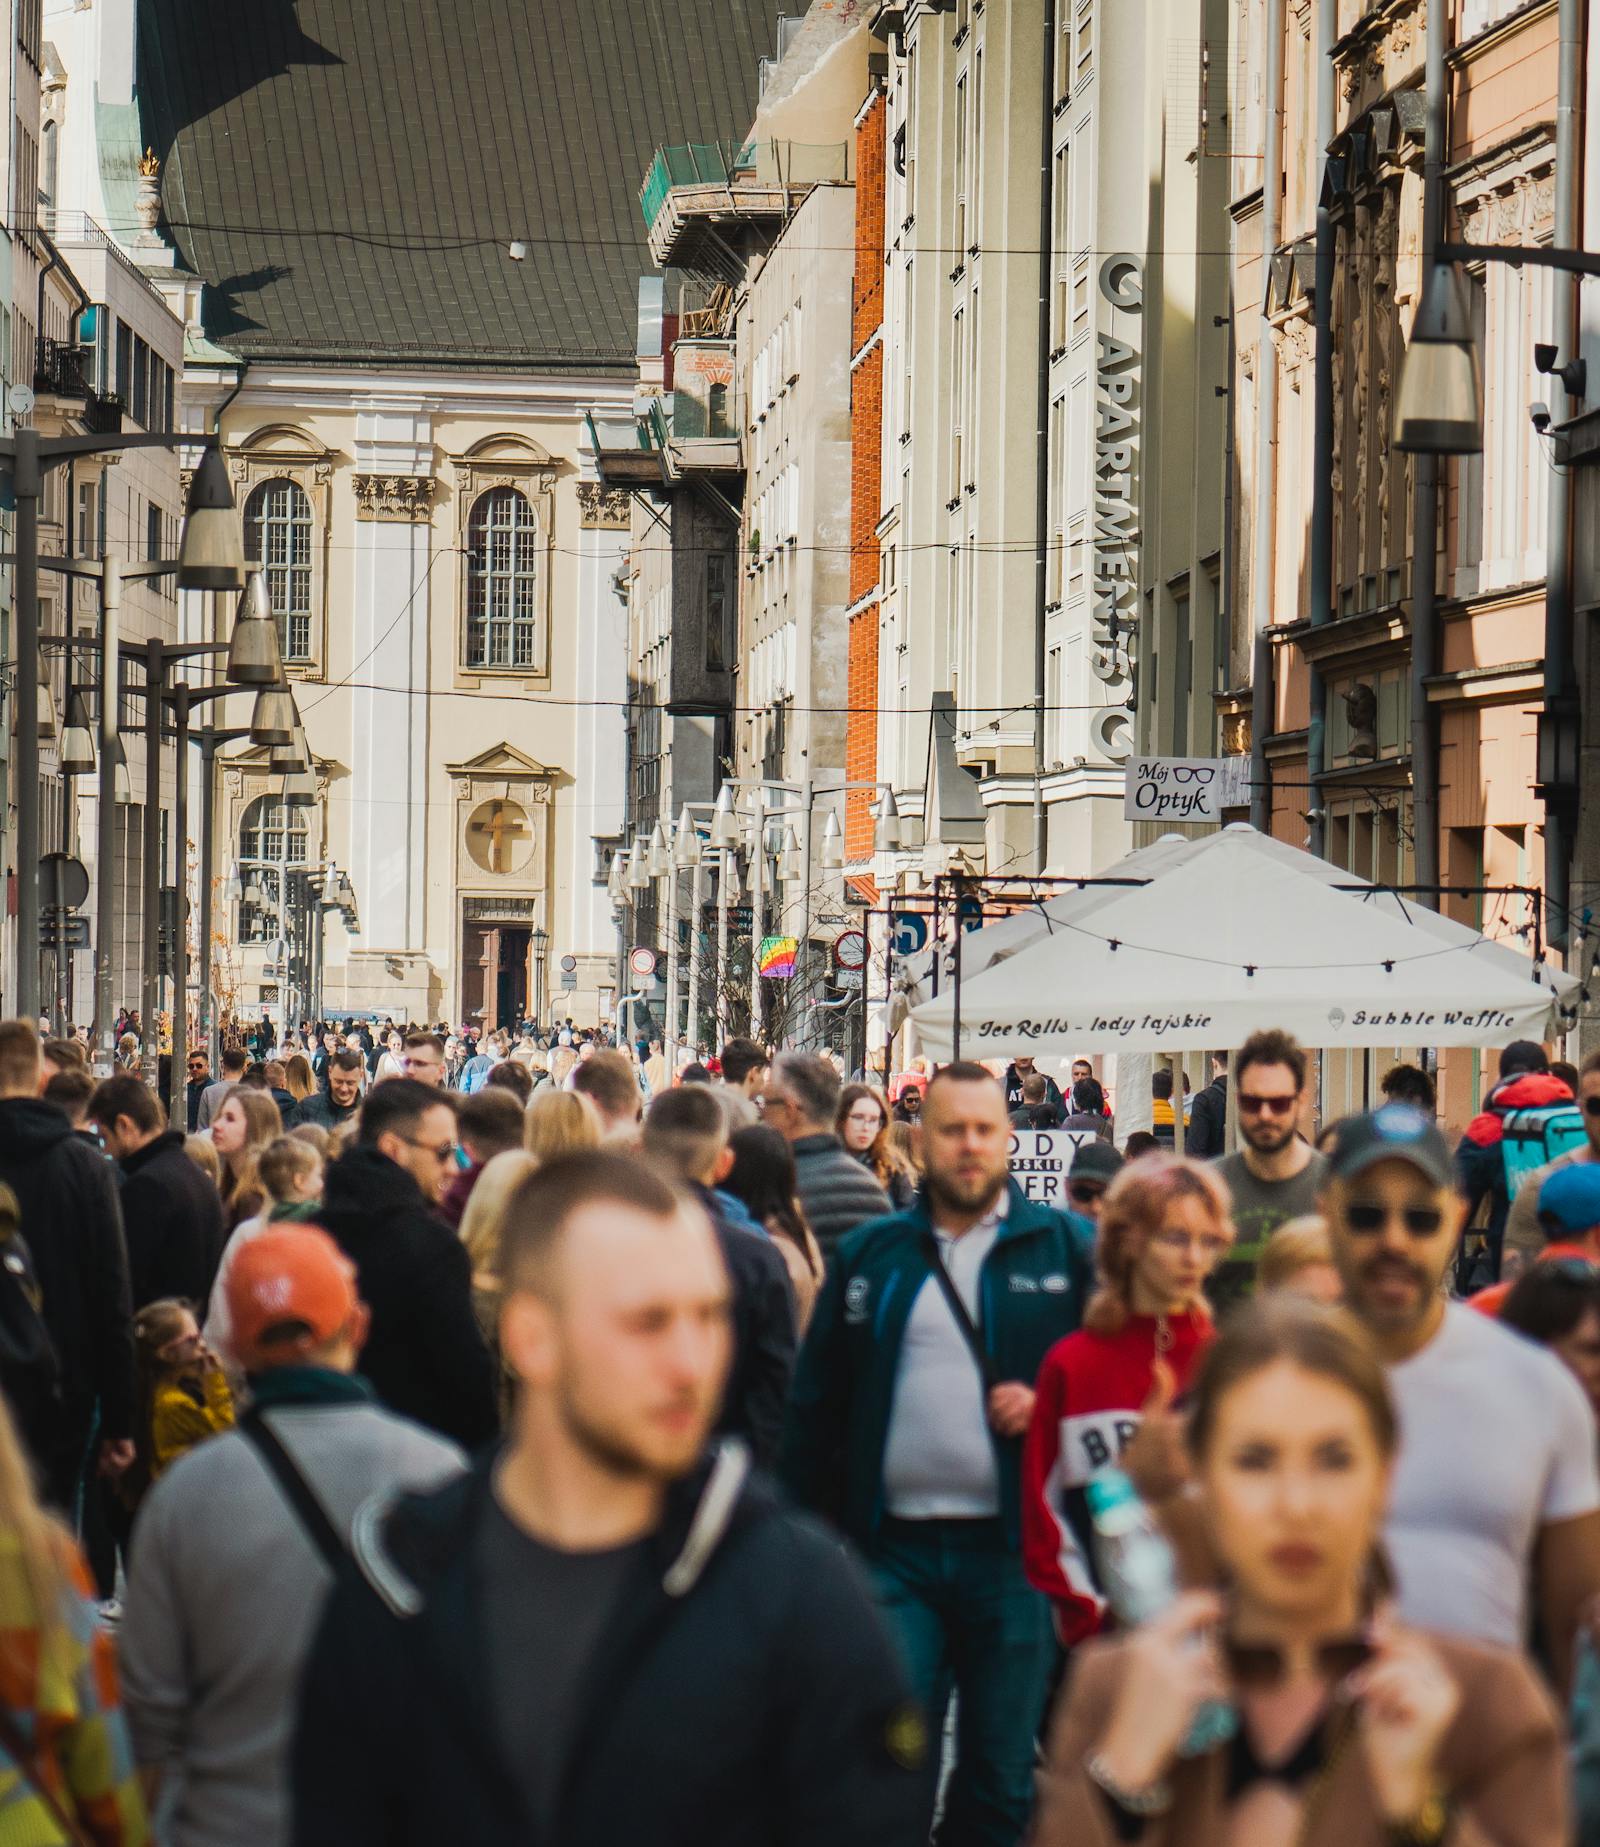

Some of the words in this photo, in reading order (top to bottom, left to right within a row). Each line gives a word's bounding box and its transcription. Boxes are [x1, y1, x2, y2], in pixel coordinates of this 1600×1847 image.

[1092, 331, 1134, 680] APARTMENTS
[1138, 762, 1169, 784] Mój
[1135, 782, 1210, 817] Optyk
[1016, 1018, 1069, 1039] Rolls
[1090, 1016, 1136, 1036] lody
[1141, 1013, 1212, 1035] tajskie
[1352, 1010, 1435, 1026] Bubble
[1443, 1010, 1514, 1028] Waffle
[1009, 1133, 1085, 1156] ODY
[1012, 1159, 1062, 1171] JSKIE
[1025, 1176, 1058, 1198] FR
